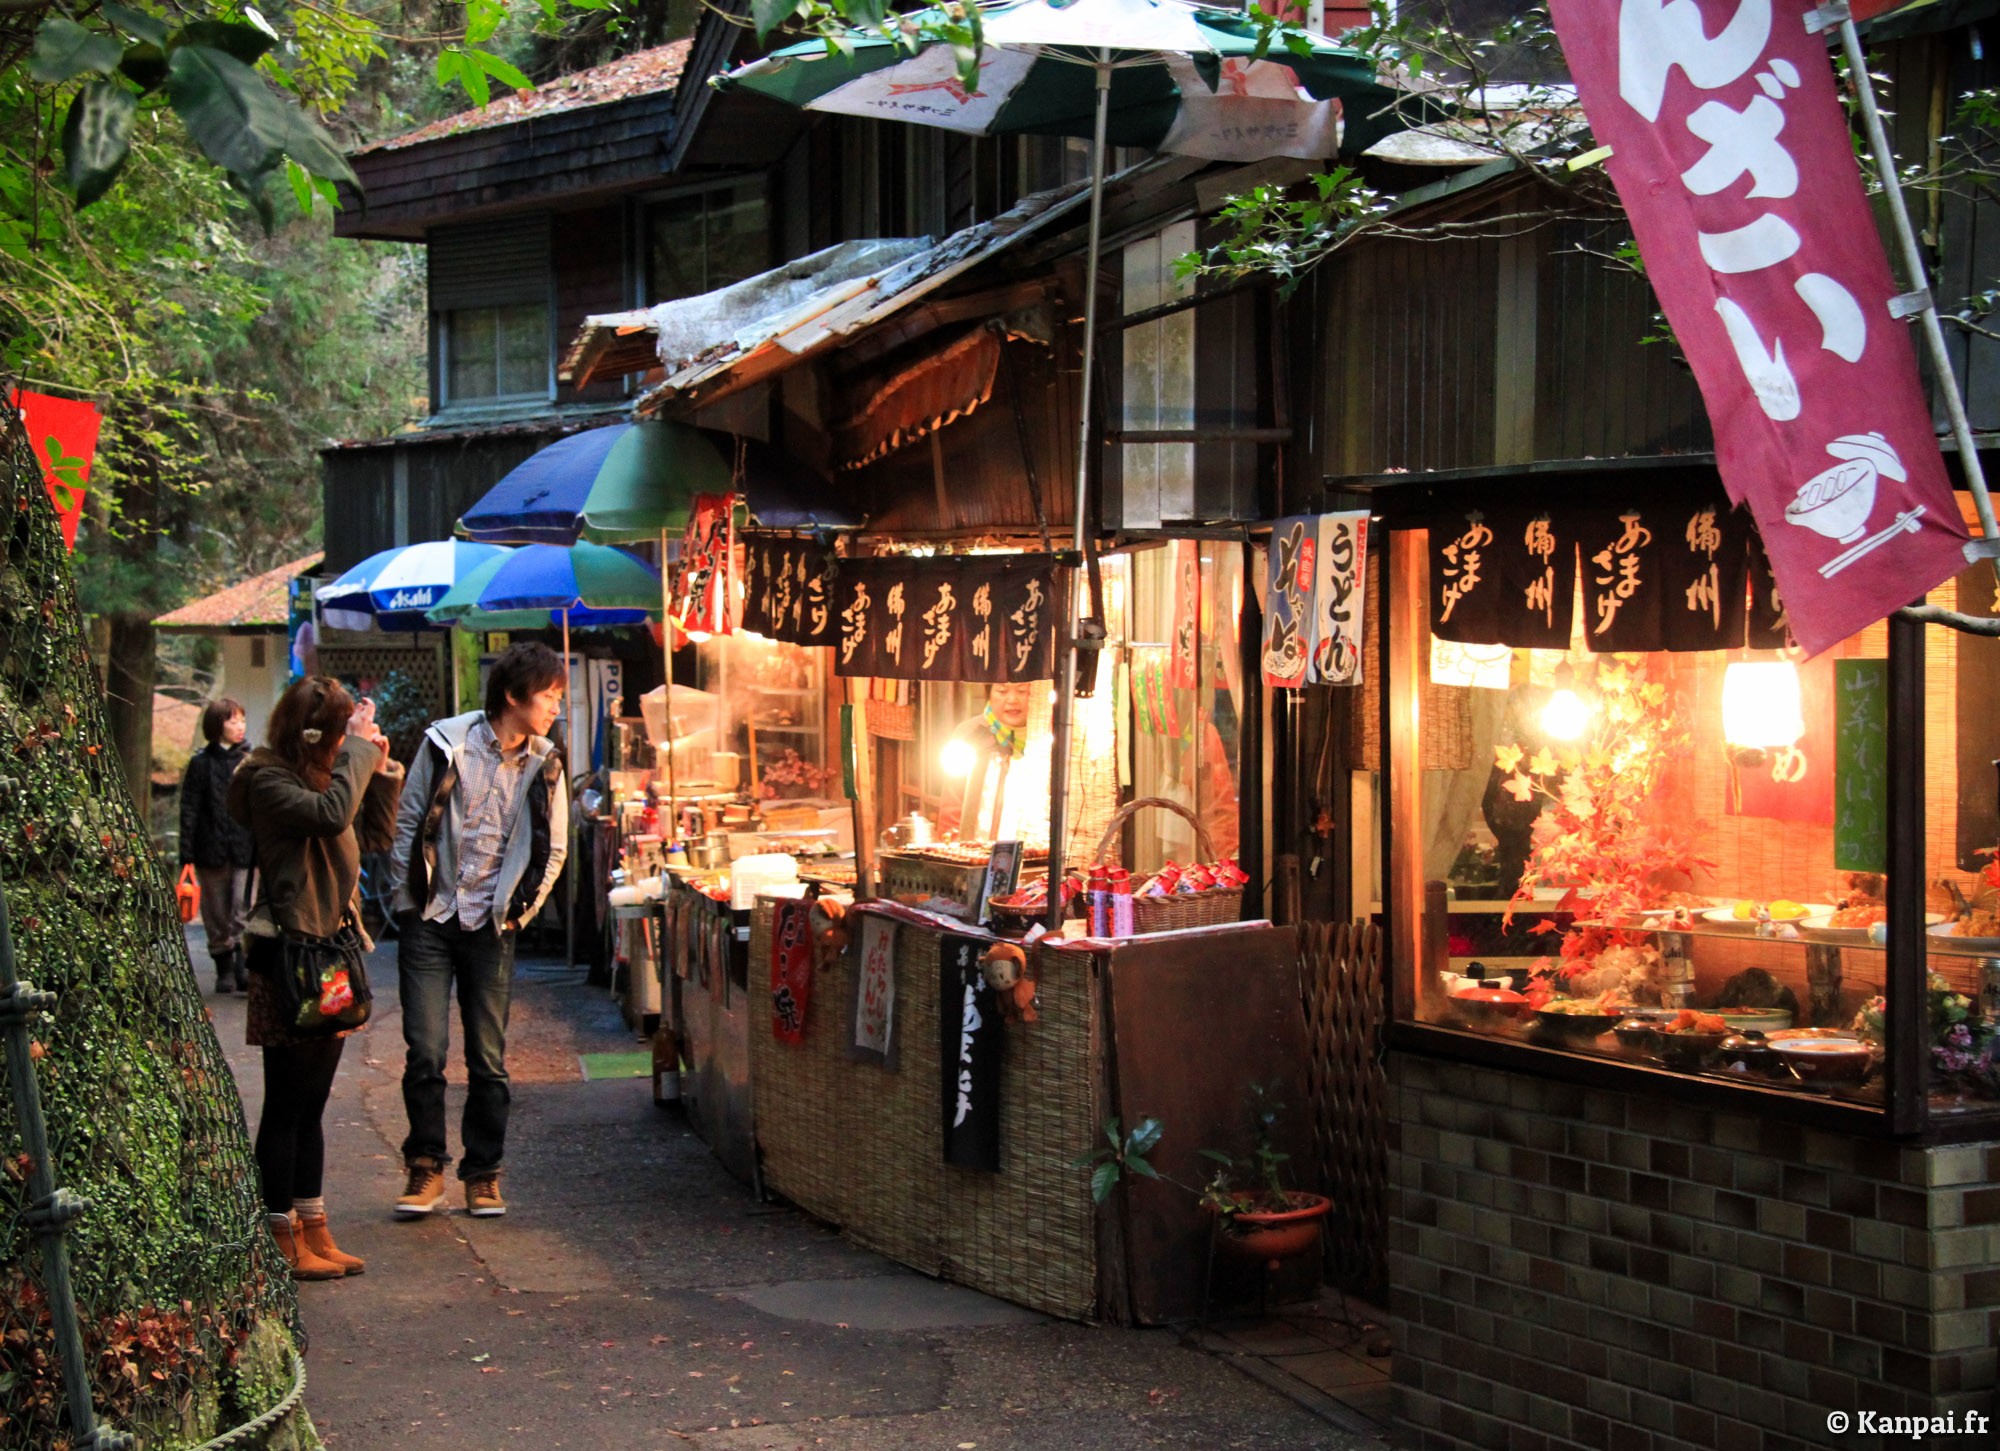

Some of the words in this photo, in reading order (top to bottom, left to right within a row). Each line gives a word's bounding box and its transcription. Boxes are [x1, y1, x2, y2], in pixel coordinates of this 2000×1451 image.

[389, 586, 432, 609] Asahi
[1325, 522, 1356, 673] うどん
